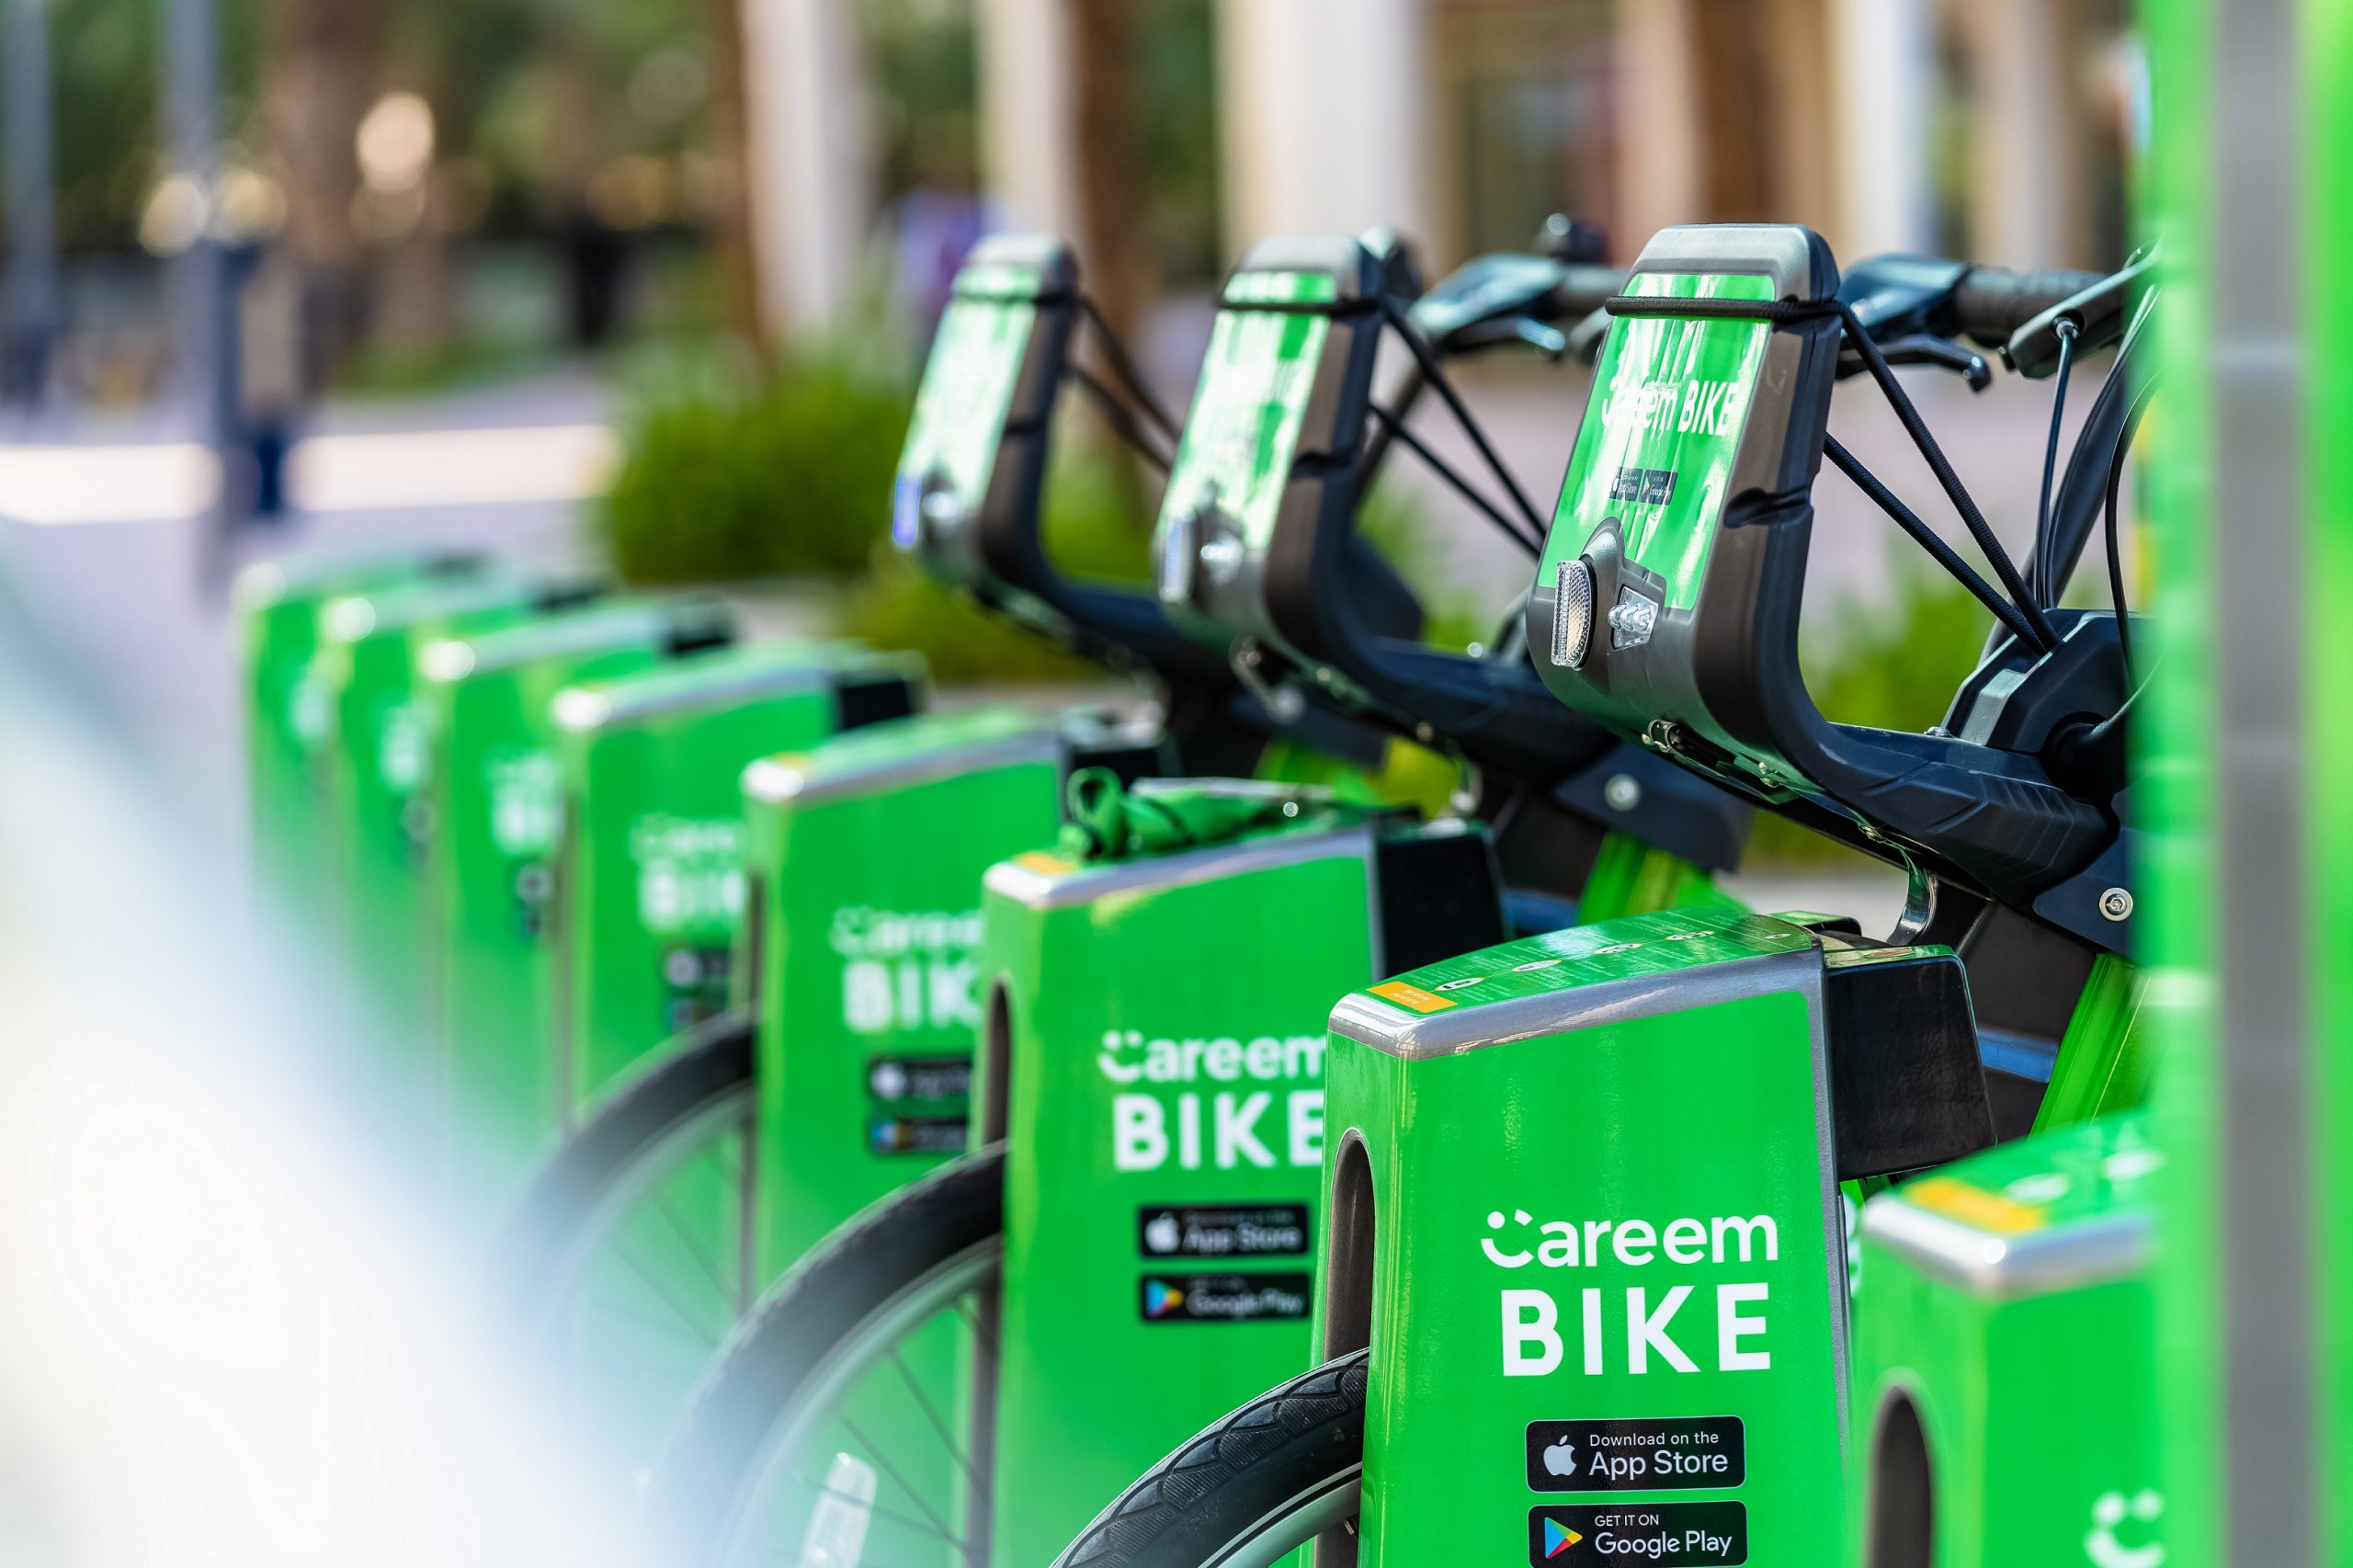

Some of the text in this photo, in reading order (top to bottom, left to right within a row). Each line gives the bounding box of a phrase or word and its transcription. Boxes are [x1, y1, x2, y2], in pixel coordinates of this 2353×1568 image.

[1677, 379, 1739, 436] BIKE
[844, 960, 982, 1031] BIK
[1097, 1029, 1327, 1083] Careem
[1113, 1089, 1324, 1171] BIKE
[1481, 1209, 1778, 1267] Careem
[1501, 1282, 1770, 1376] BIKE
[1589, 1449, 1728, 1480] App Store
[1590, 1431, 1719, 1447] Download on the
[1595, 1515, 1659, 1527] GET IT ON
[1595, 1530, 1733, 1560] Google Play
